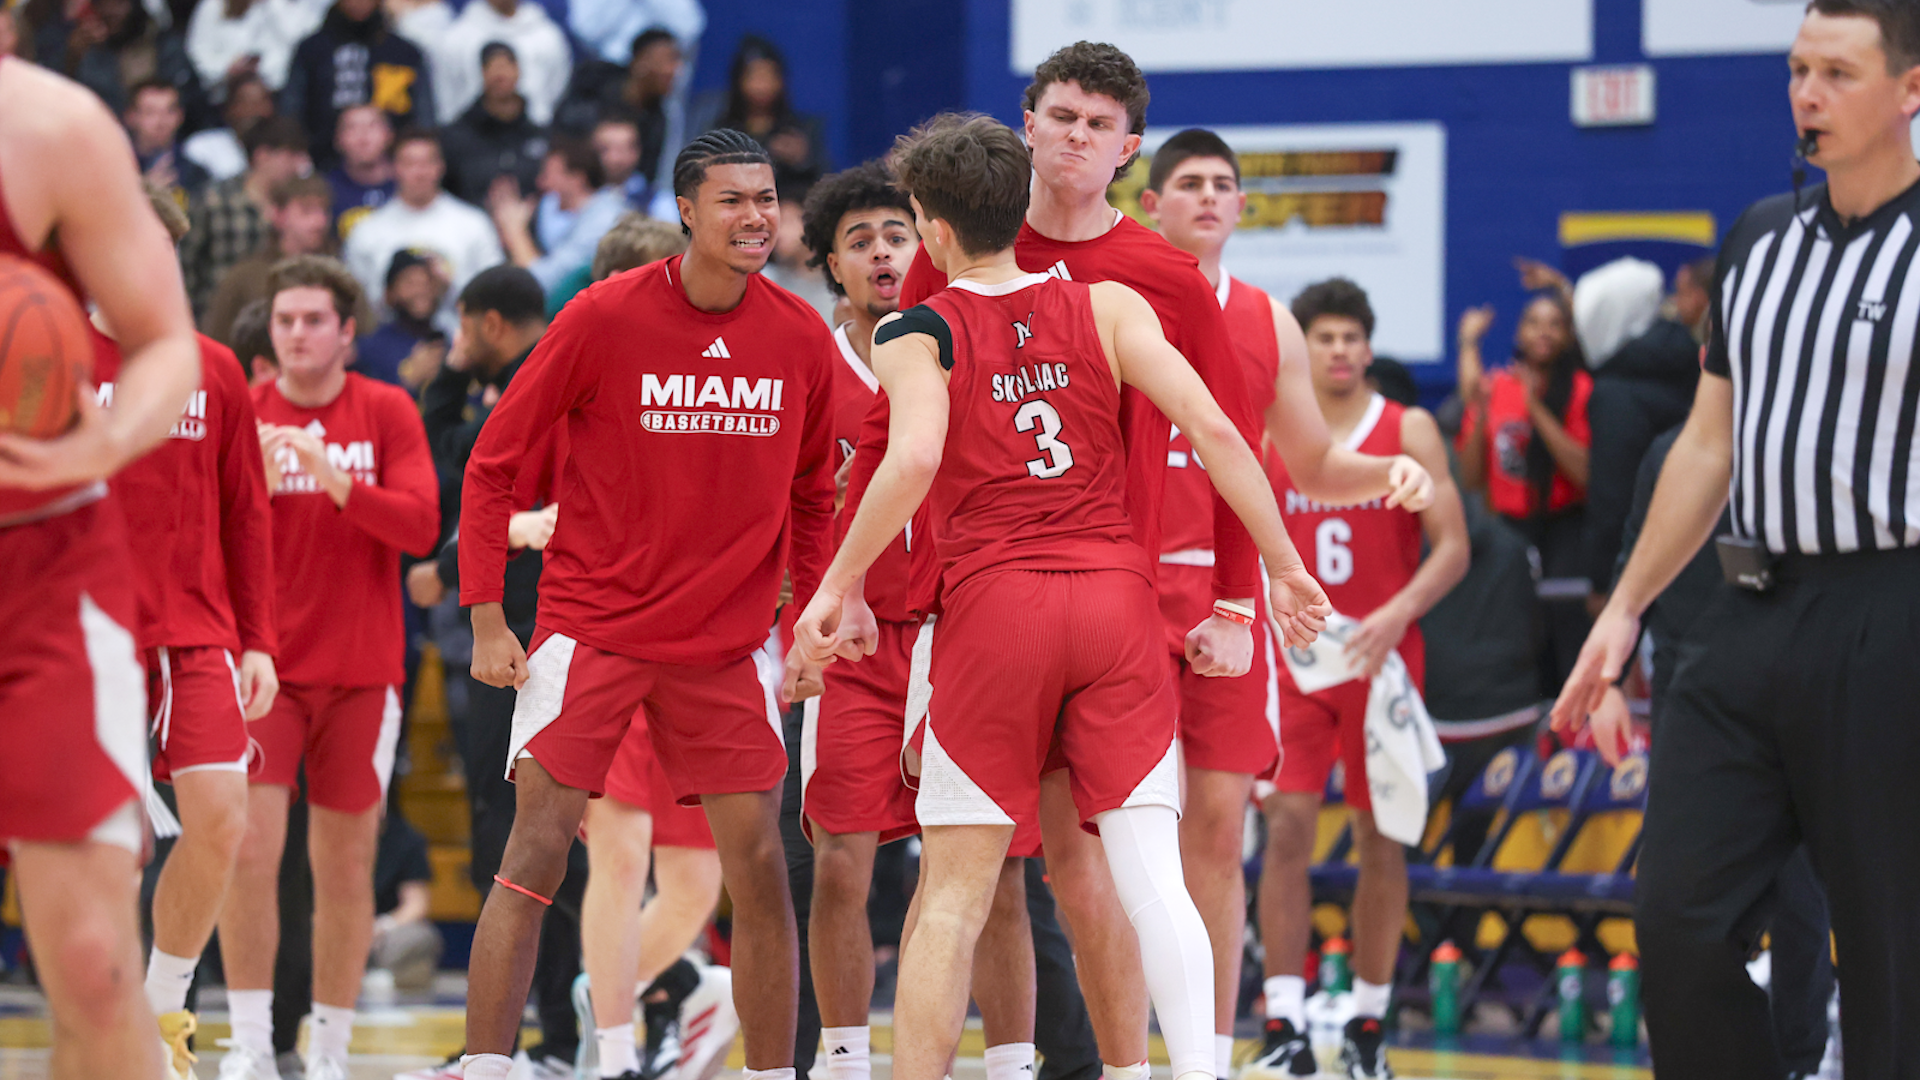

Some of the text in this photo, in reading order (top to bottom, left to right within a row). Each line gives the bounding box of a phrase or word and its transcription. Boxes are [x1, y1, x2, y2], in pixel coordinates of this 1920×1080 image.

[1857, 301, 1887, 321] TW
[640, 373, 784, 411] MIAMI
[651, 413, 769, 433] BASKETBALL
[1013, 398, 1075, 480] 3
[1315, 517, 1353, 586] 6
